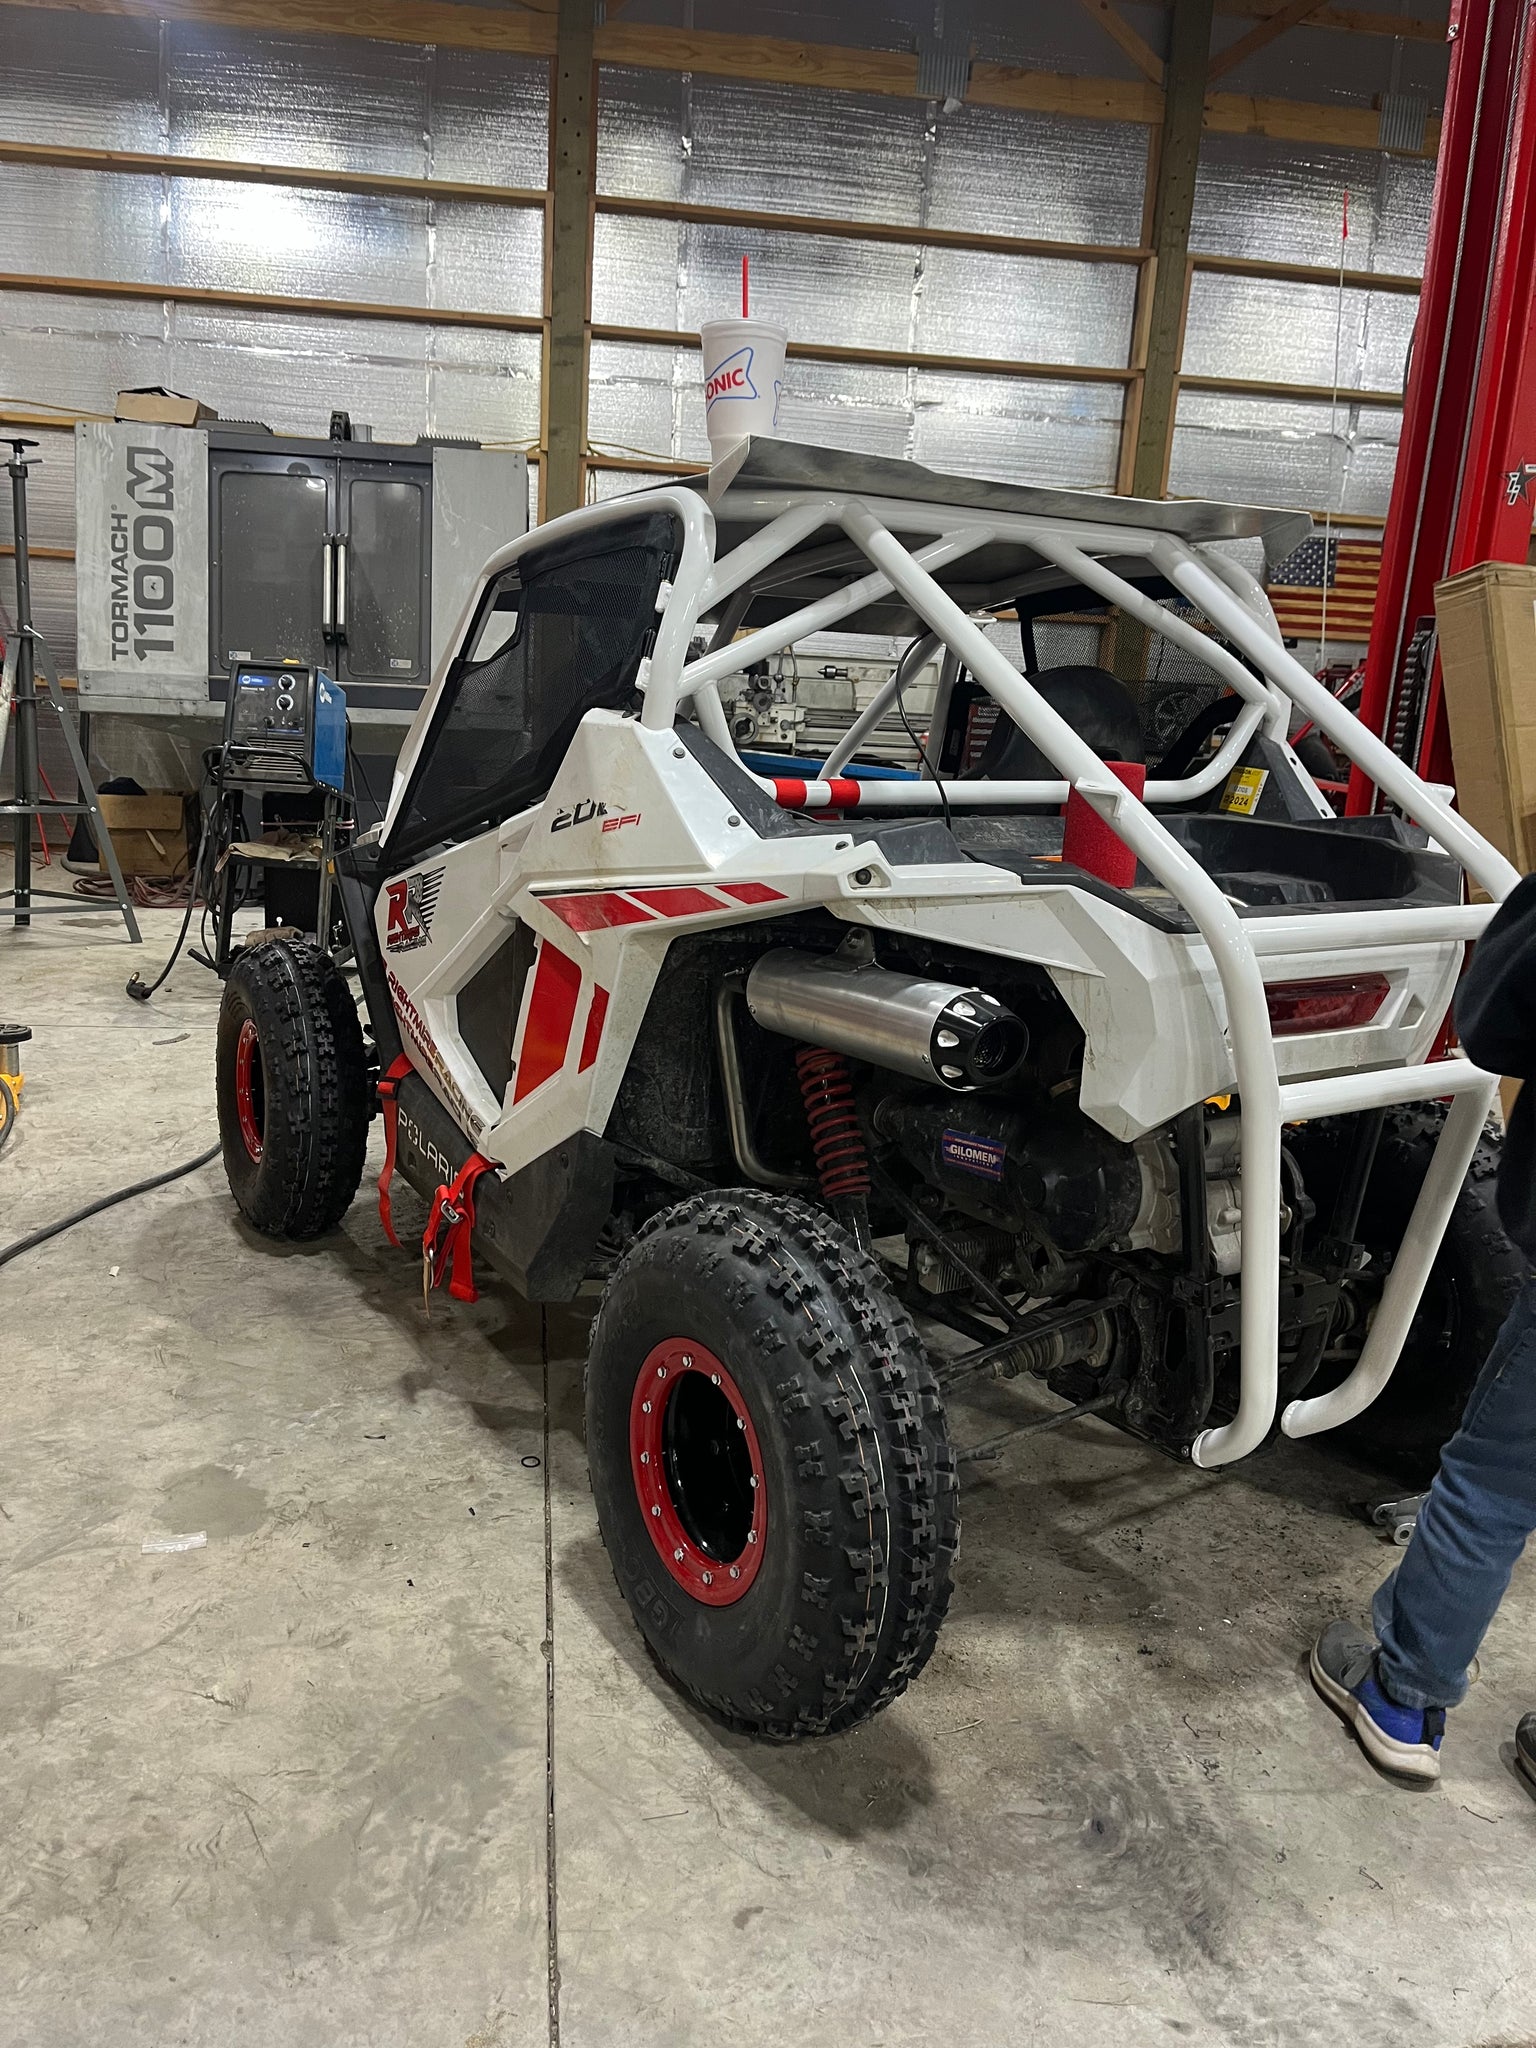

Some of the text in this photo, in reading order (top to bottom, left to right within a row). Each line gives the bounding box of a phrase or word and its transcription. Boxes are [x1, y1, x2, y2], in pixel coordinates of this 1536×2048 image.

[706, 368, 745, 400] ONIC
[1229, 795, 1249, 806] 2024
[602, 812, 642, 832] EFI
[949, 1144, 997, 1165] GILOMEN
